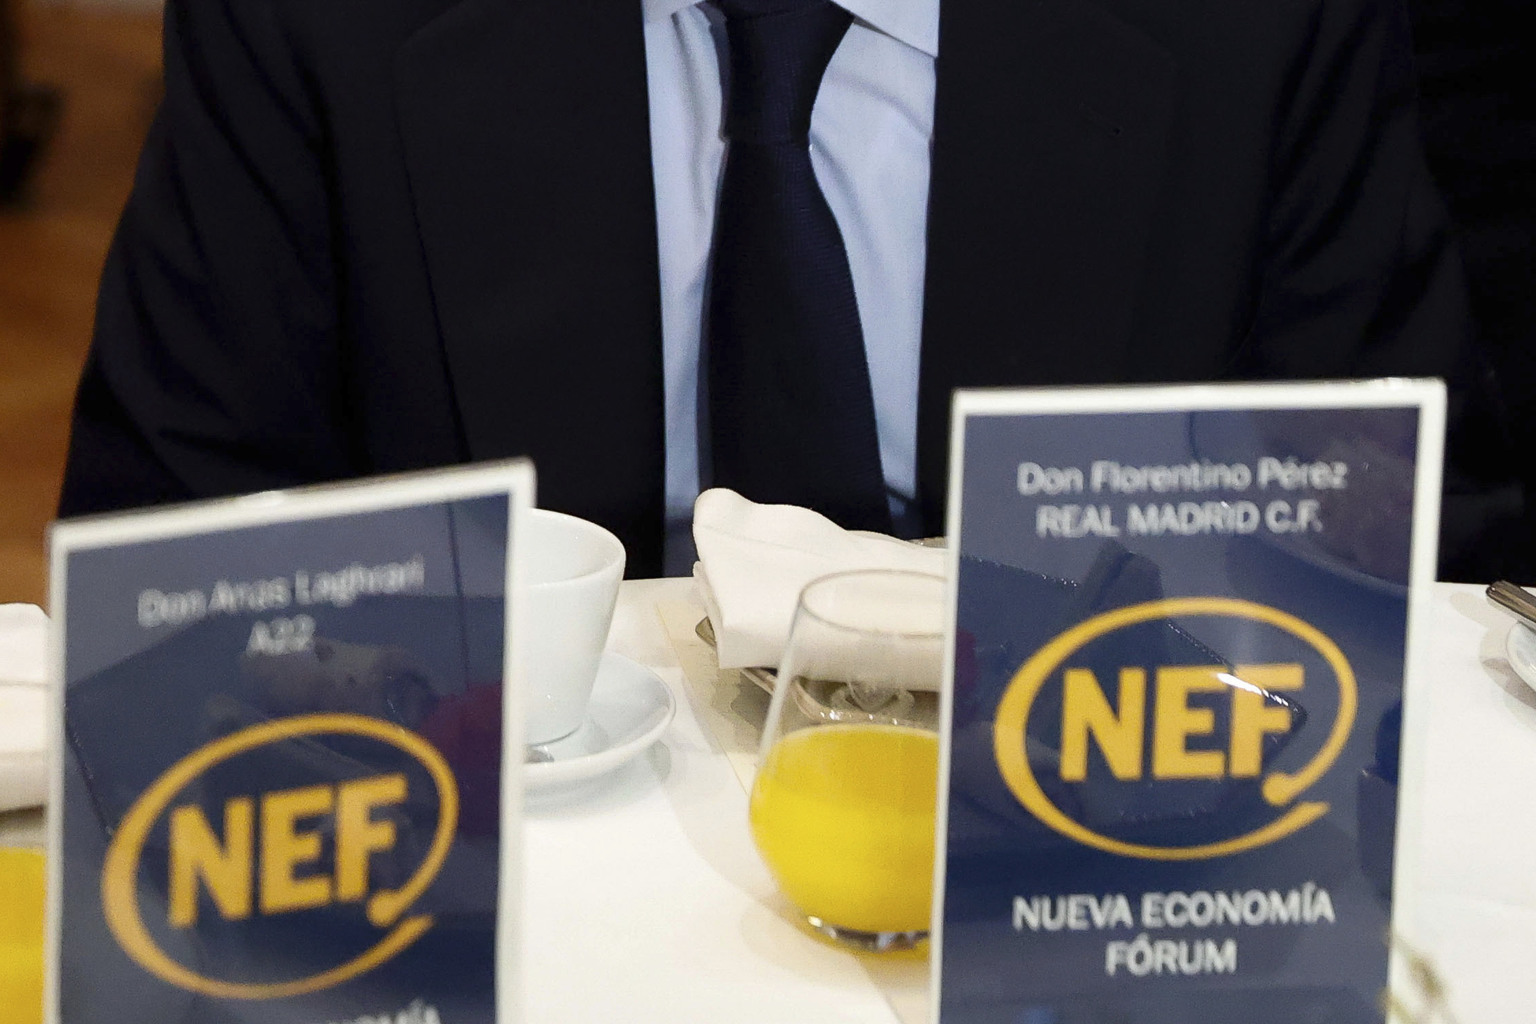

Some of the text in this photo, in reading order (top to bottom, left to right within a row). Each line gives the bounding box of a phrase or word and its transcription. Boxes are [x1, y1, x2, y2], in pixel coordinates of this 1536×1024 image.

[1017, 456, 1349, 496] Don Florentino Pérez
[1035, 499, 1323, 538] REAL MADRID C.F.
[137, 588, 207, 627] Don
[246, 614, 315, 659] A22
[1059, 663, 1305, 782] NEF
[168, 774, 409, 929] NEF
[1013, 880, 1336, 931] NUEVA ECONOMÍA
[1105, 931, 1237, 977] FÓRUM
